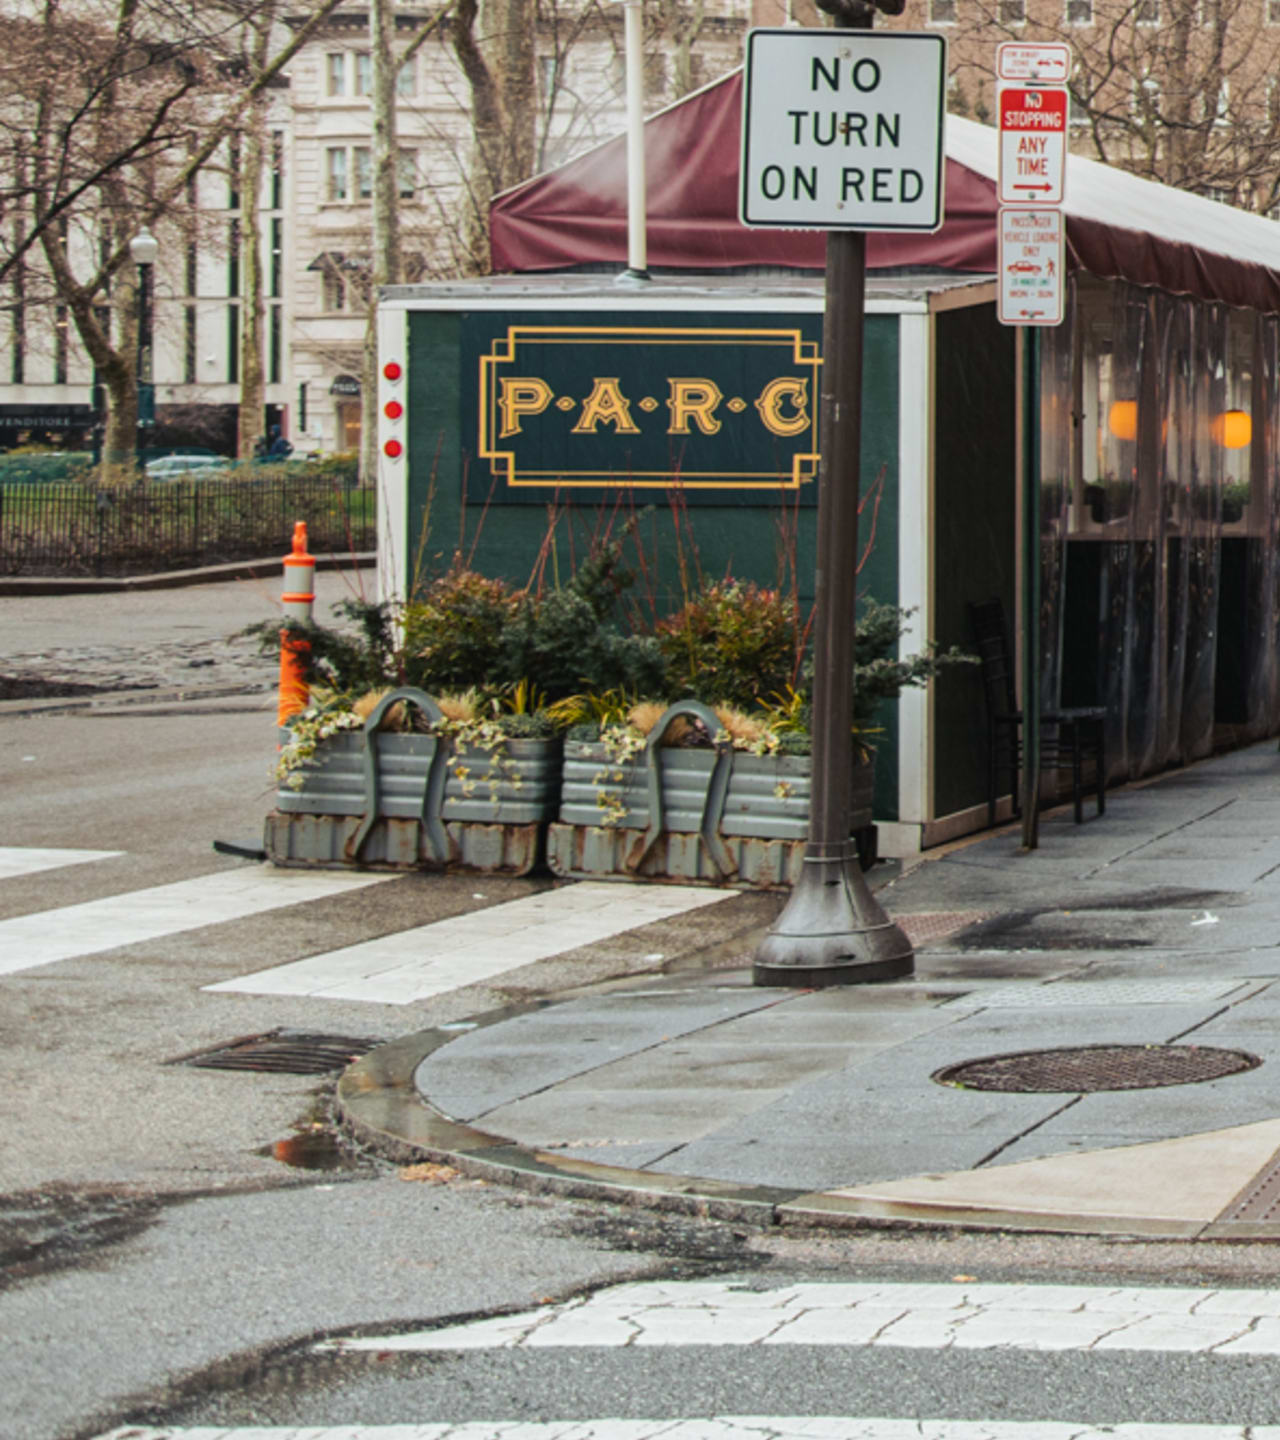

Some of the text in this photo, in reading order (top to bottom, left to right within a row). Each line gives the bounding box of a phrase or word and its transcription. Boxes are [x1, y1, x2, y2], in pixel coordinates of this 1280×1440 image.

[811, 57, 881, 92] NO
[1024, 92, 1043, 108] NO
[1004, 111, 1062, 128] STOPPING
[788, 111, 900, 148] TURN
[1018, 137, 1047, 154] ANY
[1016, 158, 1048, 176] TIME
[761, 165, 924, 203] ON RED
[1011, 217, 1051, 228] PASSENGER
[1004, 231, 1059, 243] VEHICLE LOADING
[1022, 245, 1040, 257] ONLY
